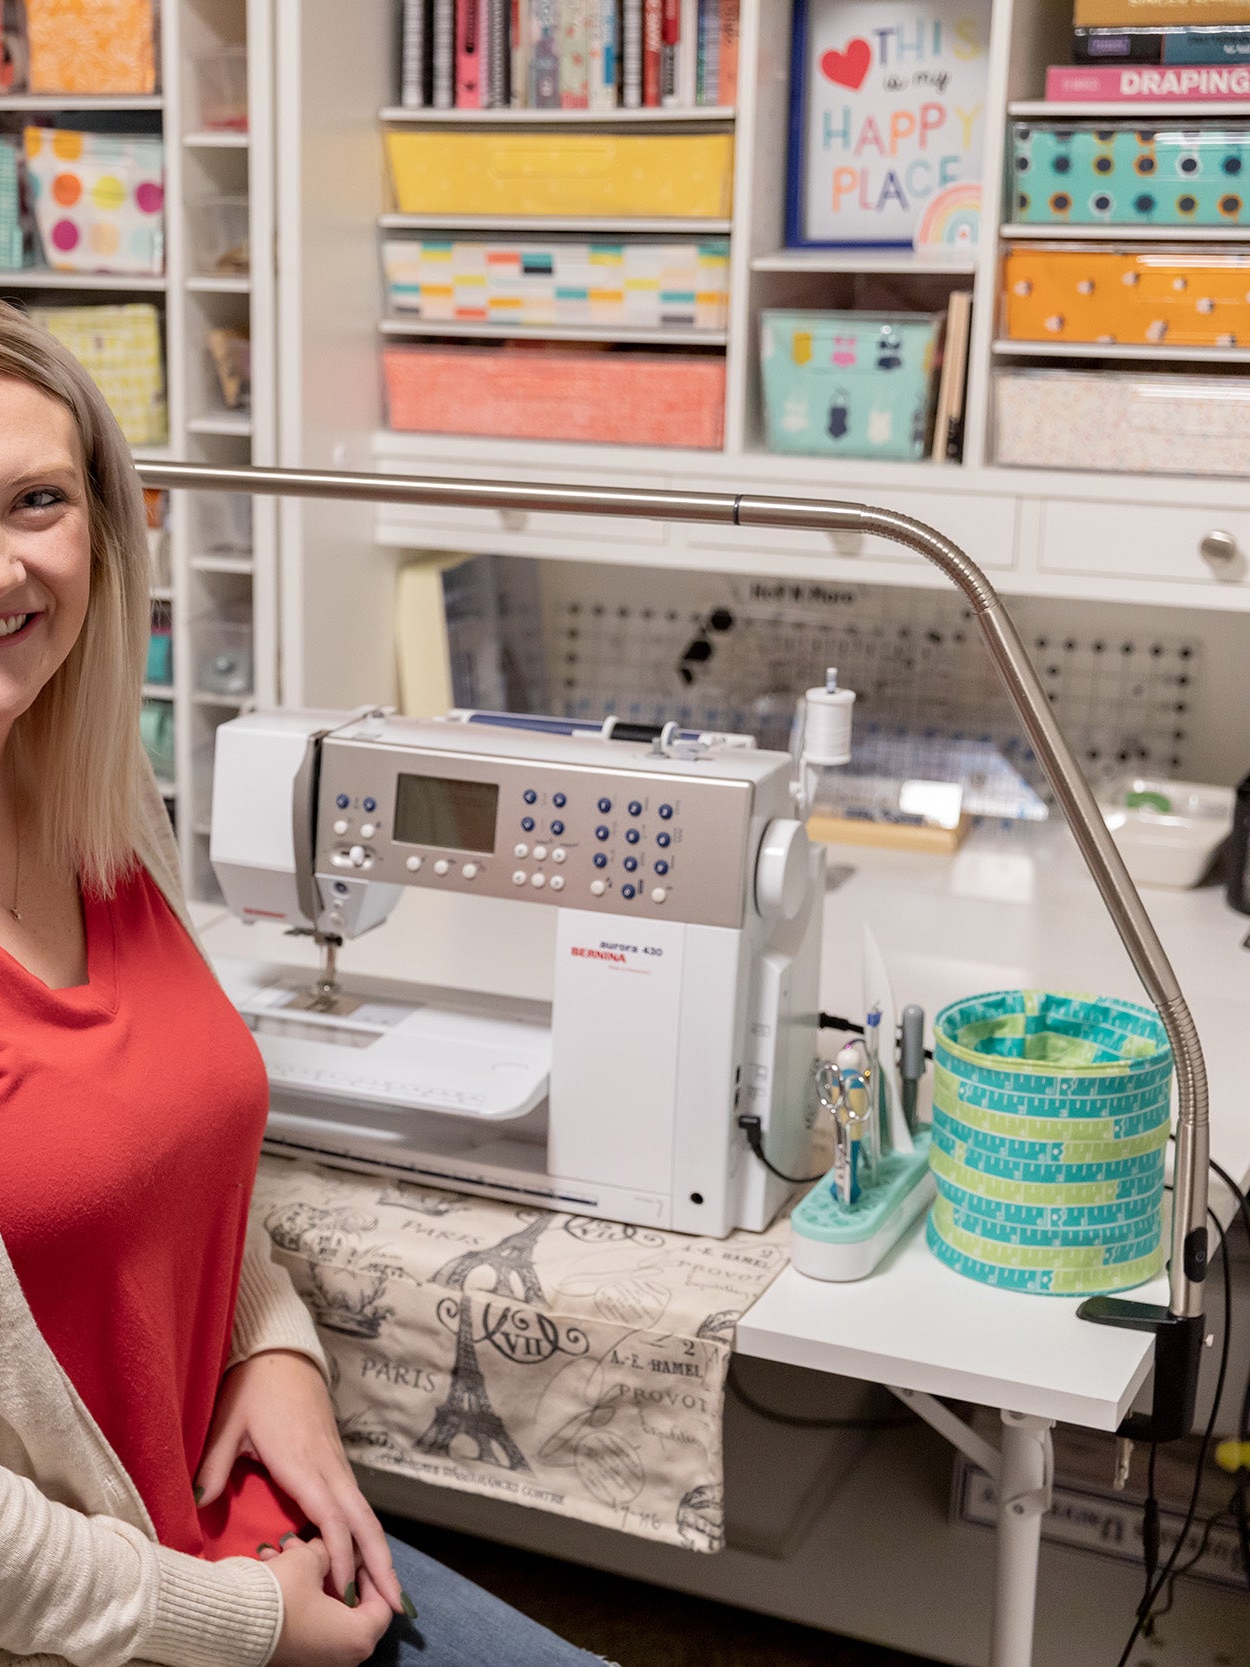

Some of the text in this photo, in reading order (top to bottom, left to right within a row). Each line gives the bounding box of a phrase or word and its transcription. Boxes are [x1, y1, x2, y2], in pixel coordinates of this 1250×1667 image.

[873, 17, 981, 66] THIS
[1120, 68, 1250, 95] DRAPING
[822, 102, 985, 158] HAPPY
[831, 155, 961, 213] PLACE
[571, 946, 627, 963] BERNINA
[599, 941, 638, 954] aurora
[501, 1331, 543, 1356] VII
[683, 1340, 696, 1356] 2
[361, 1357, 436, 1393] PARIS
